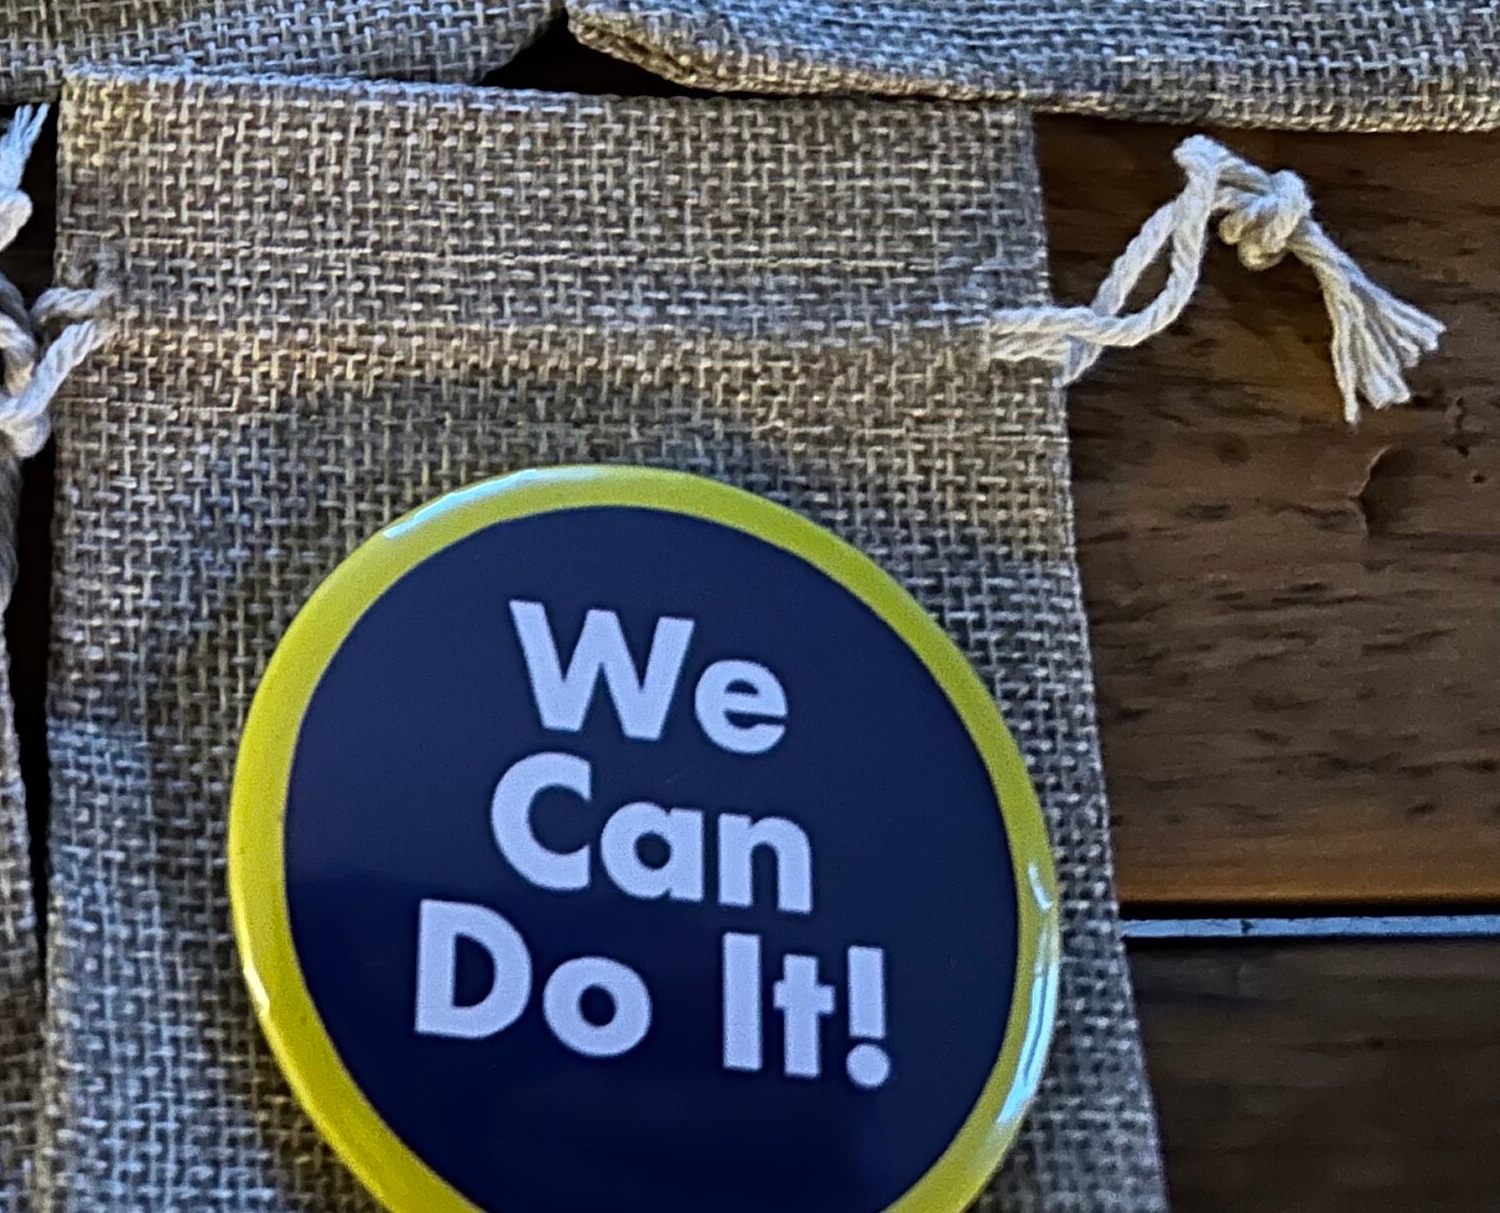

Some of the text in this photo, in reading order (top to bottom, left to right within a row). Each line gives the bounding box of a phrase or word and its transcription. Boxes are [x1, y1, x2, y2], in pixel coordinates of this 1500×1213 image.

[507, 598, 789, 755] We
[490, 751, 814, 915] Can
[413, 897, 893, 1091] Do It!
